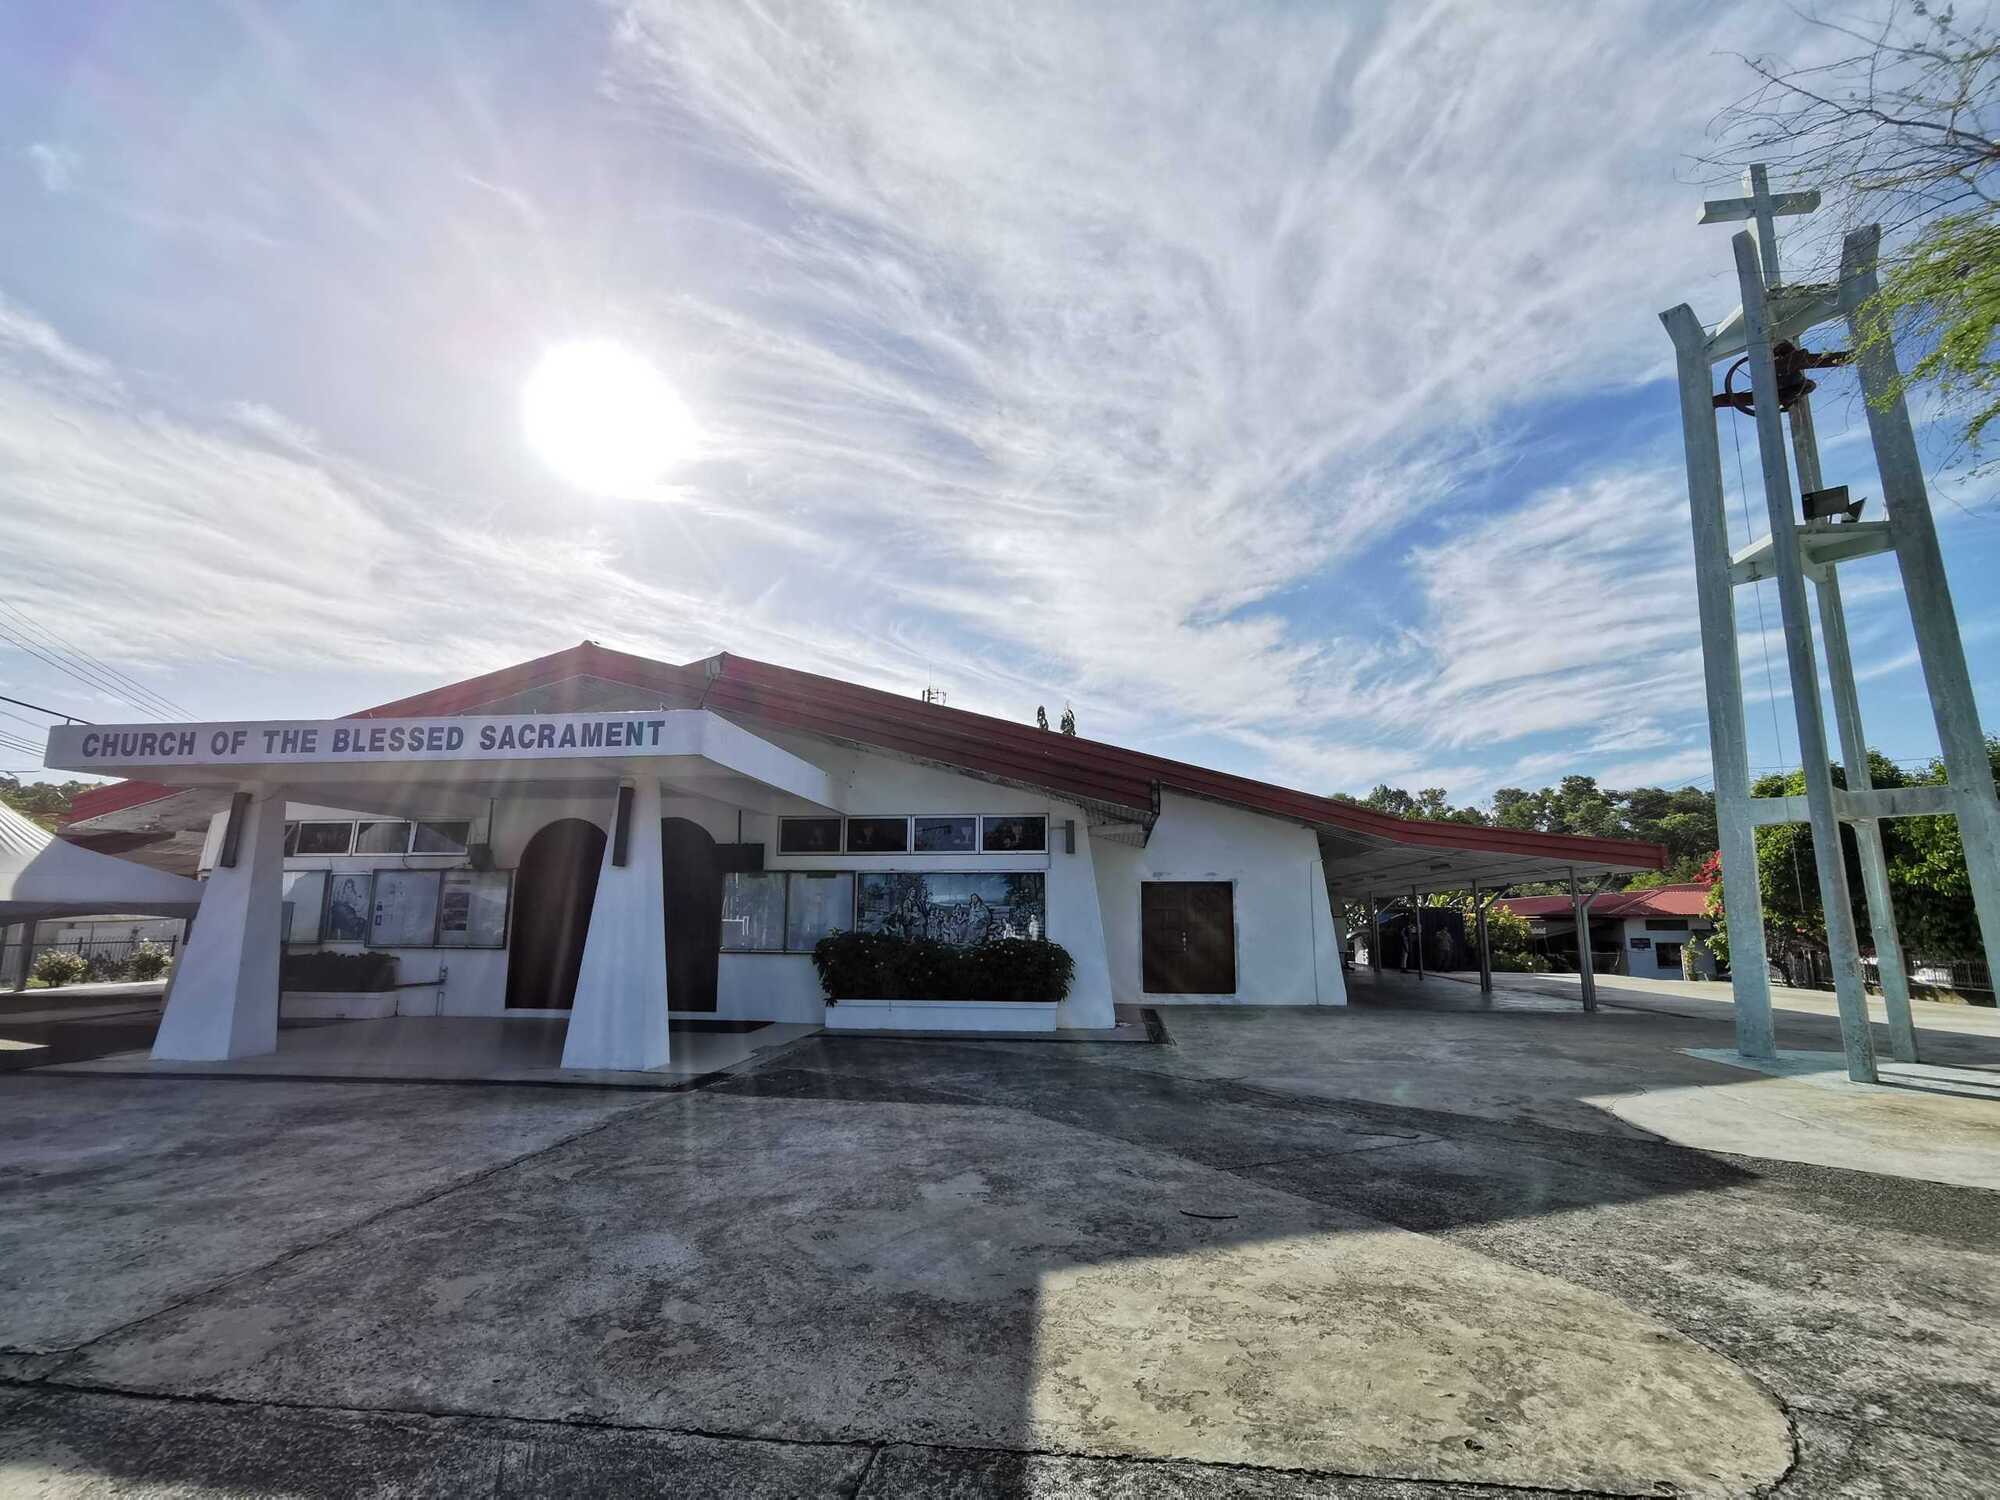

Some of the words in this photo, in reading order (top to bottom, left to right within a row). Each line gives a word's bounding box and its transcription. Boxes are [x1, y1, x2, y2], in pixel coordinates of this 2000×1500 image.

[82, 731, 197, 758] CHURCH
[210, 731, 248, 755] OF
[263, 729, 318, 754] THE
[332, 726, 464, 753] BLESSED
[479, 720, 666, 750] SACRAMENT
